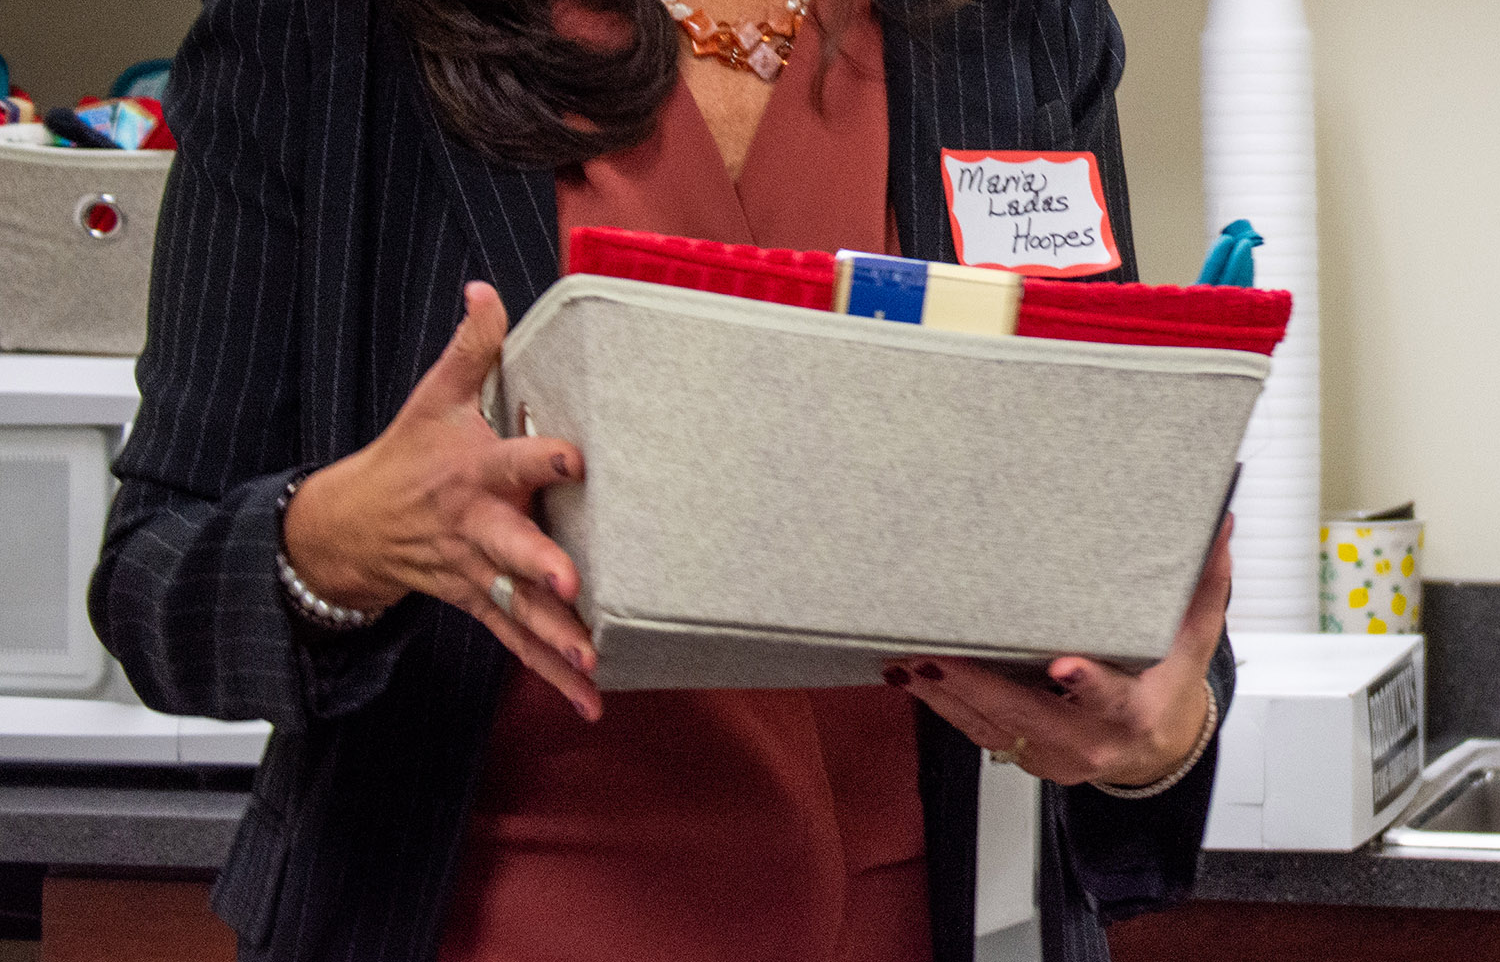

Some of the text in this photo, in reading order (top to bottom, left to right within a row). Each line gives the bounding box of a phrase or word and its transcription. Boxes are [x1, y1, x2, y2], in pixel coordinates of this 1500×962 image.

[957, 166, 1048, 195] Maria
[988, 192, 1070, 217] Ladas
[1011, 217, 1096, 257] Hoopes
